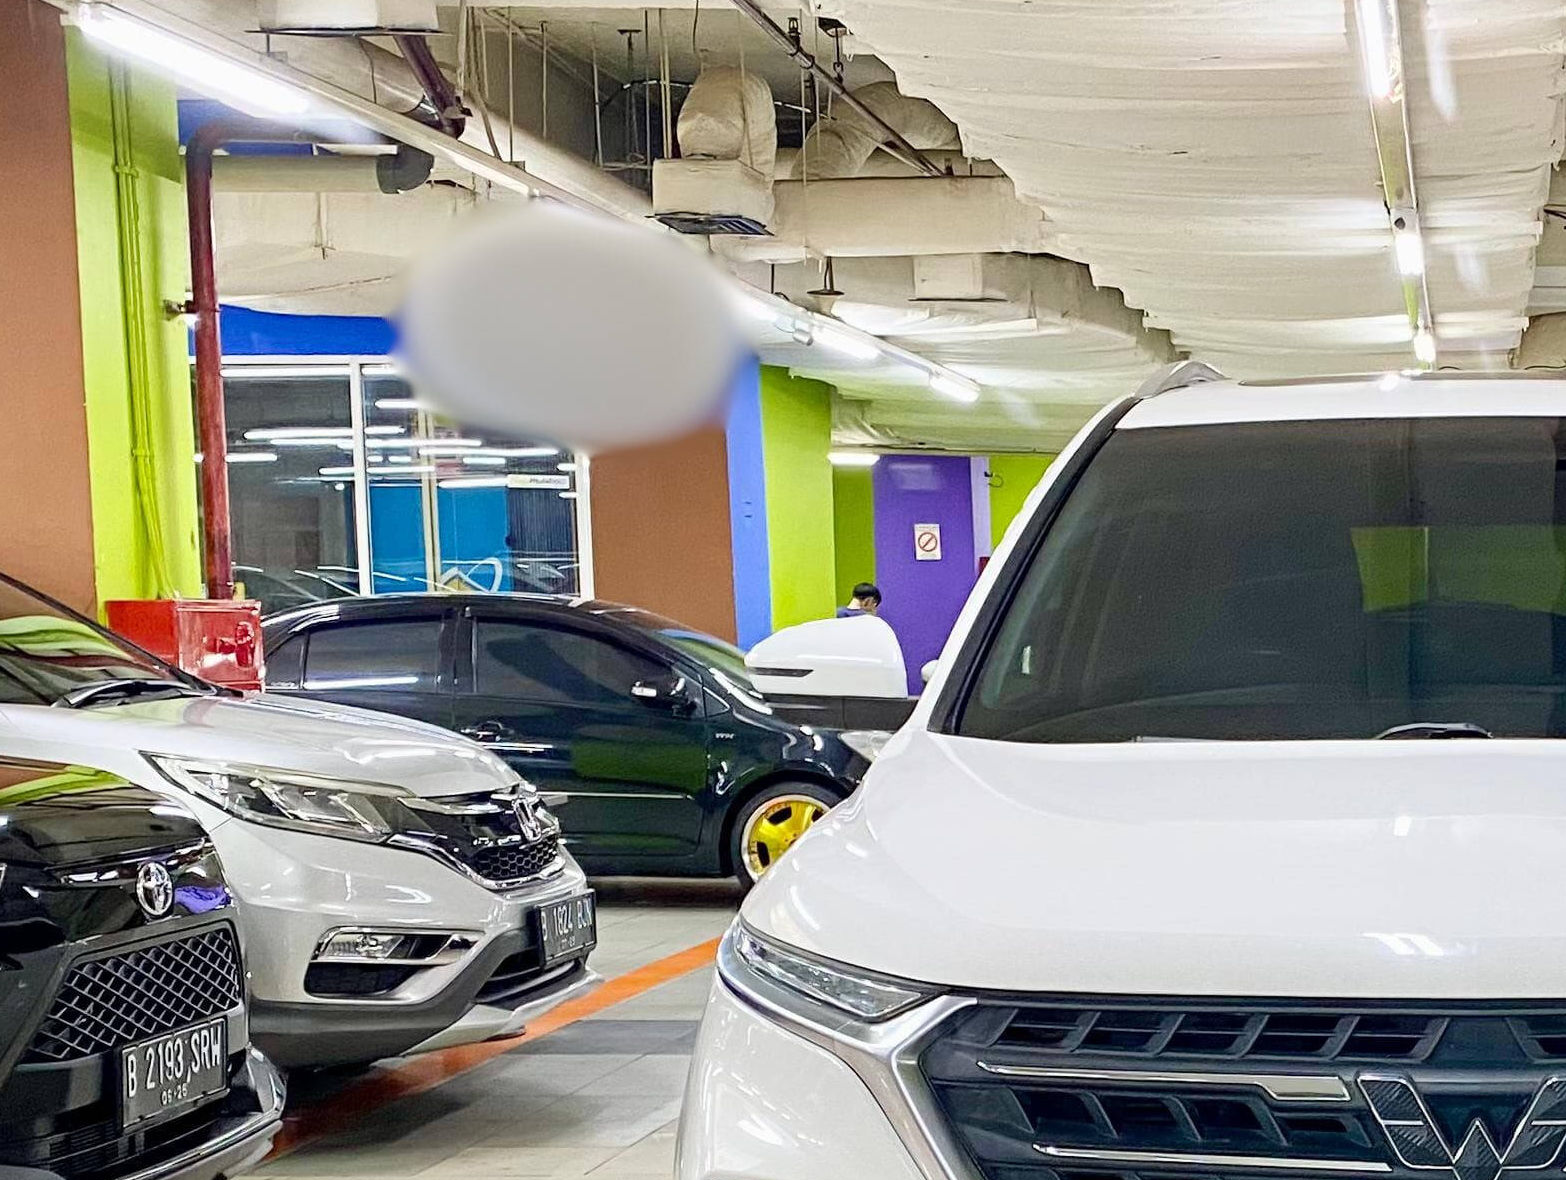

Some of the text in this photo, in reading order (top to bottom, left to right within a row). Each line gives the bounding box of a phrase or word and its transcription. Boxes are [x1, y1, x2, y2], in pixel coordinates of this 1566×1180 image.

[541, 910, 548, 941] B
[127, 1024, 221, 1098] B 2193 SRW
